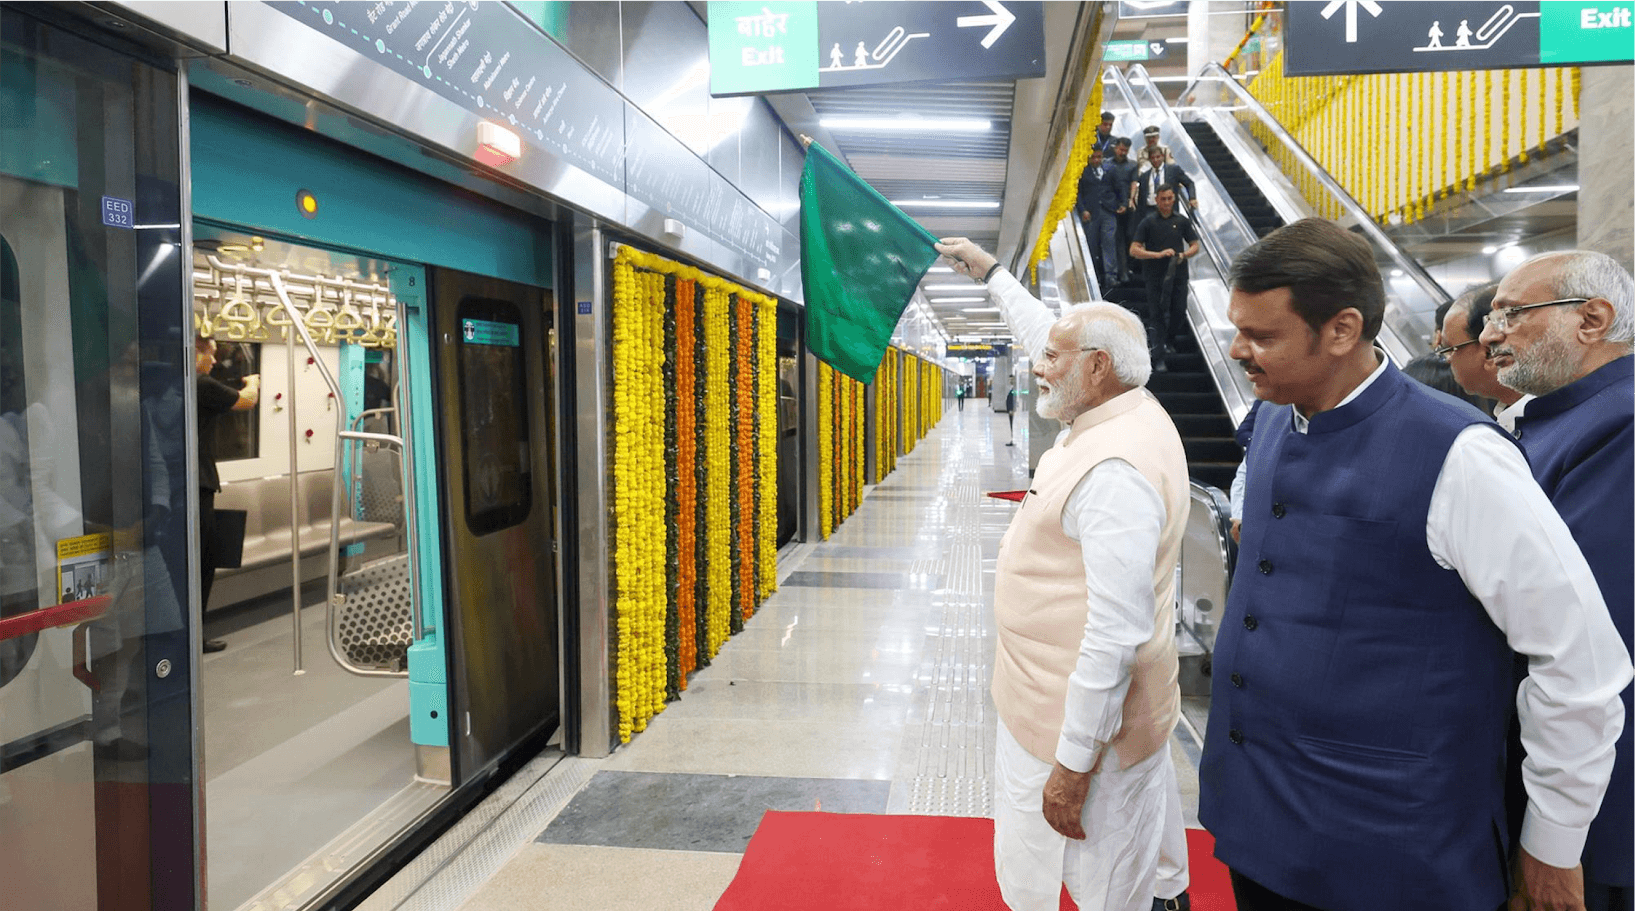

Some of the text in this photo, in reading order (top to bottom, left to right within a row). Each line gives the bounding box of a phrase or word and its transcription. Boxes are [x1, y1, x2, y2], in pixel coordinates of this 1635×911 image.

[386, 15, 401, 35] Grant
[734, 7, 789, 38] बाहेर
[1580, 6, 1632, 29] Exit
[741, 45, 785, 67] Exit
[107, 201, 128, 213] EED
[108, 213, 127, 224] 332
[408, 276, 416, 287] 8
